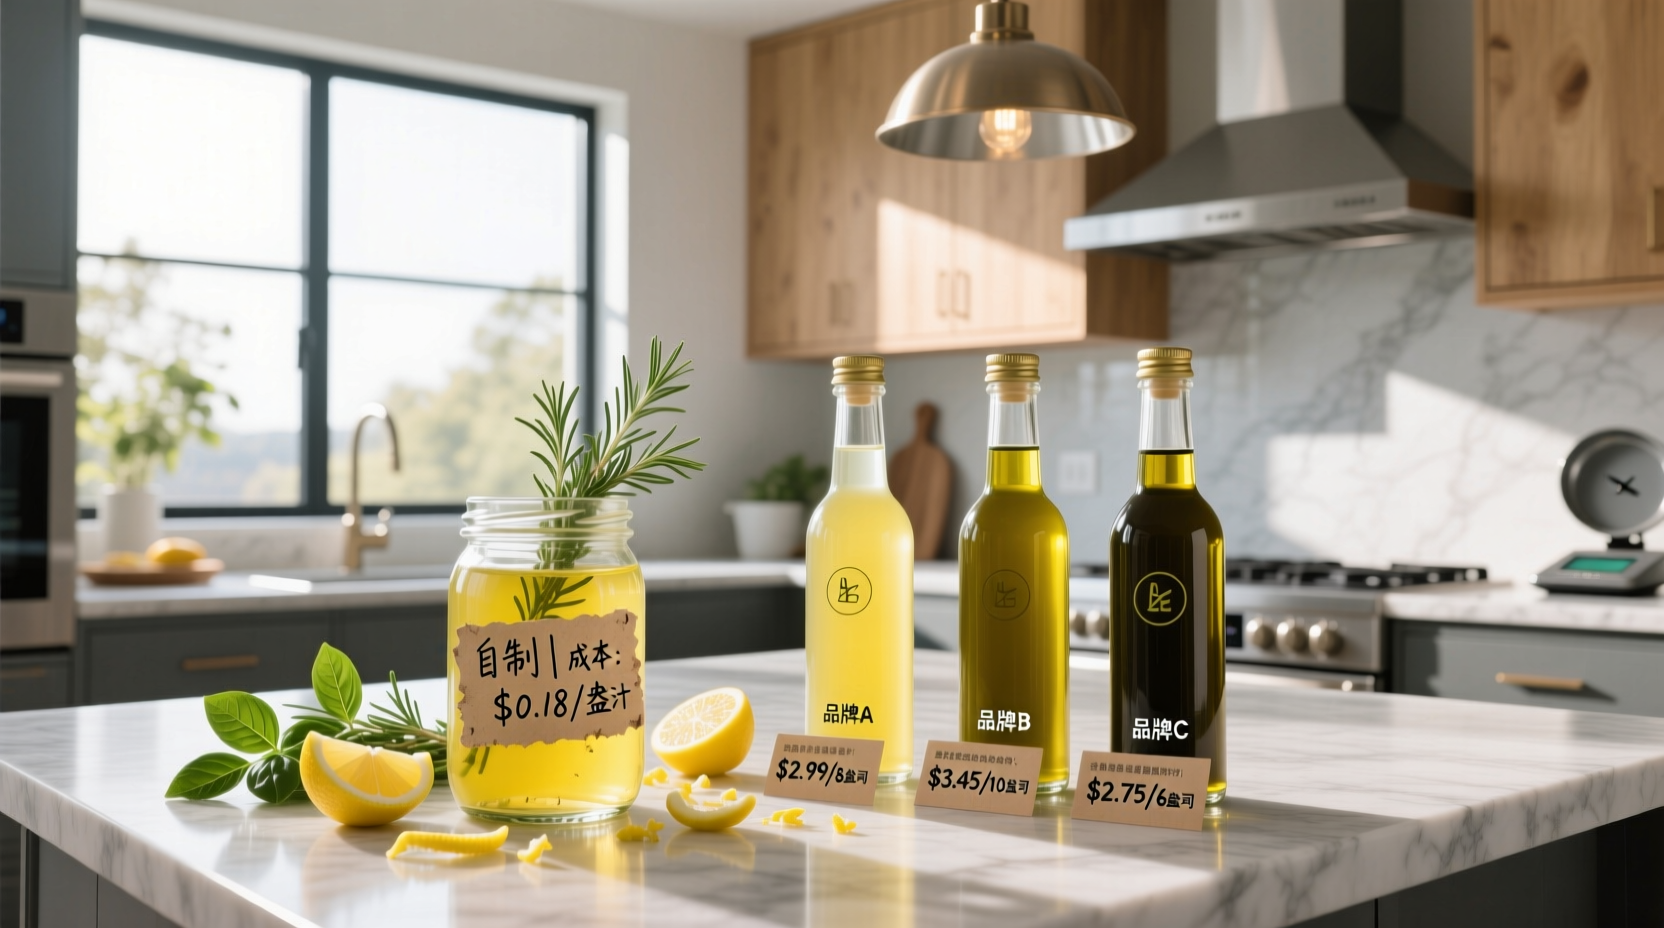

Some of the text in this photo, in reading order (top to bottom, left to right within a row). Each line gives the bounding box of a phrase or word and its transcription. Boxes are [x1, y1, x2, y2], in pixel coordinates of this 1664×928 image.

[823, 703, 874, 725] 品牌A
[977, 709, 1031, 732] 品牌B
[1132, 717, 1189, 741] 品牌C
